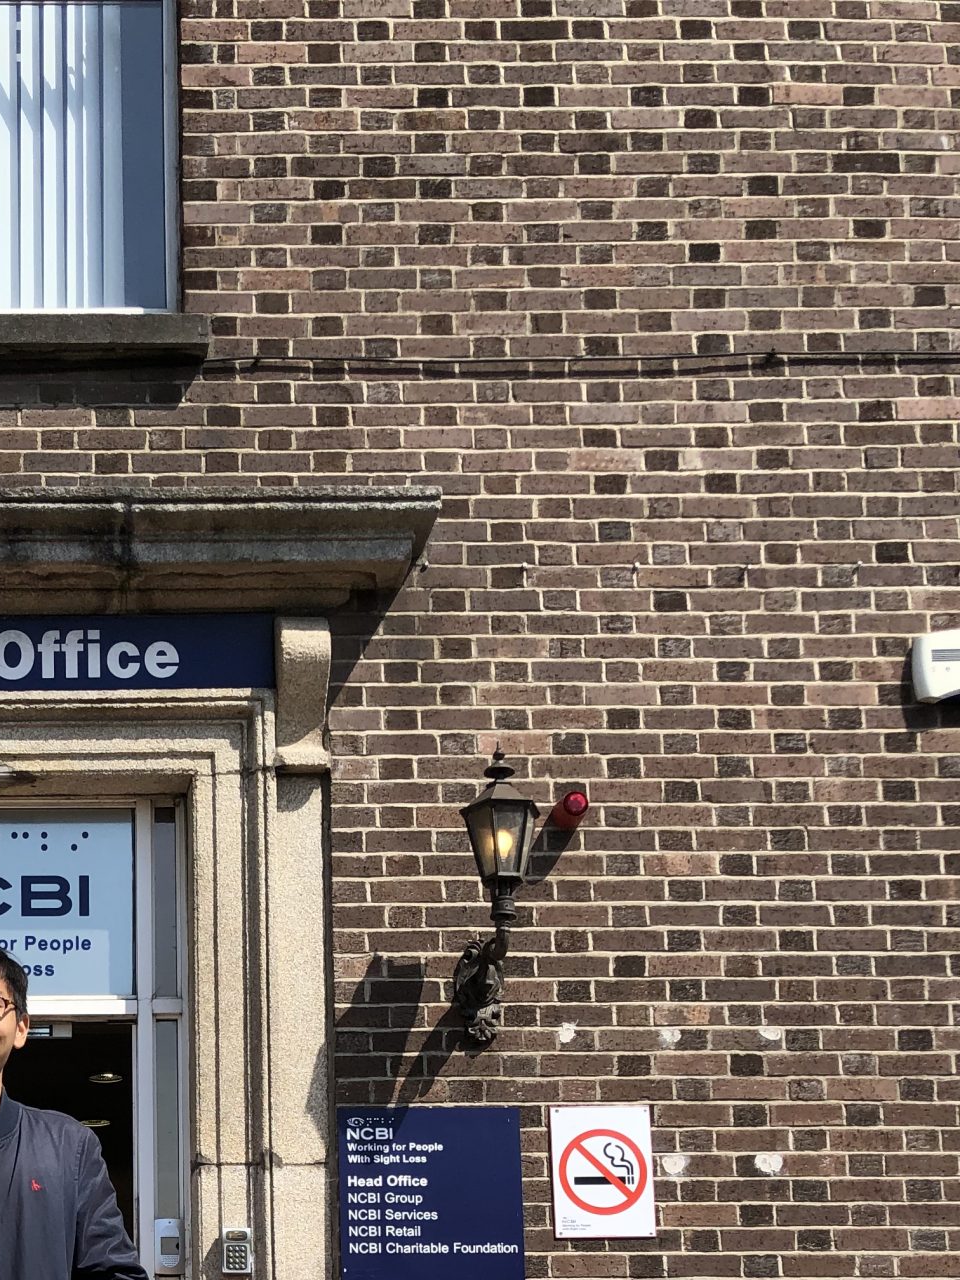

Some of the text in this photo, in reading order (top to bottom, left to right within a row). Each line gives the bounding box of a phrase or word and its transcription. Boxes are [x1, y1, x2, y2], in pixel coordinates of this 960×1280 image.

[24, 935, 92, 954] People
[25, 965, 55, 977] oss
[346, 1127, 393, 1140] NCBI
[347, 1142, 444, 1153] Working for People
[347, 1154, 427, 1165] With Sight Loss
[347, 1175, 428, 1187] Head Office
[347, 1193, 423, 1205] NCBI Group
[348, 1209, 438, 1220] NCBI Services
[348, 1226, 421, 1237] NCBI Retail
[349, 1242, 518, 1254] NCBI Charitable Foundation
